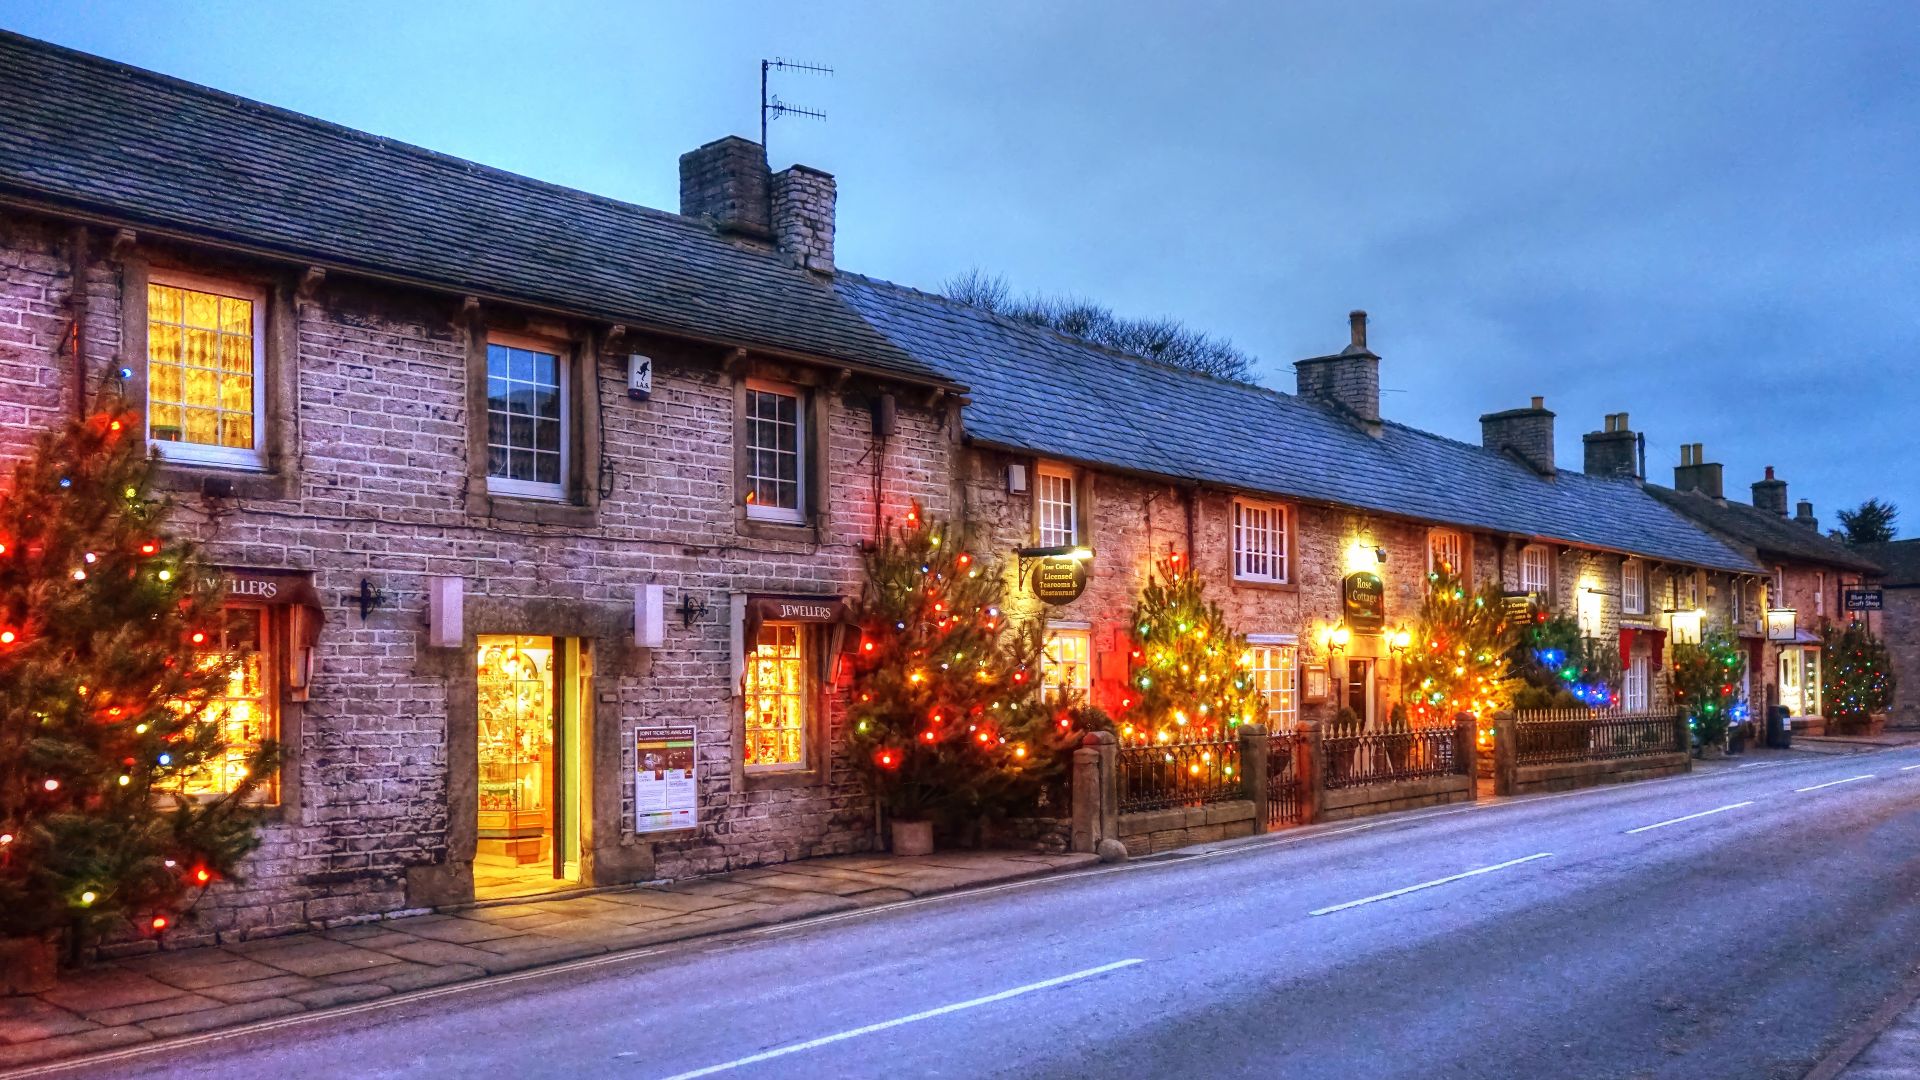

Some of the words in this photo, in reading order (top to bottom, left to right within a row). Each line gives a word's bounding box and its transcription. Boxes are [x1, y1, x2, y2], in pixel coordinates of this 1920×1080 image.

[184, 578, 277, 598] JEWLLERS
[1357, 577, 1372, 589] Rose
[1352, 590, 1378, 605] Cottage
[780, 604, 831, 619] JEWELLERS
